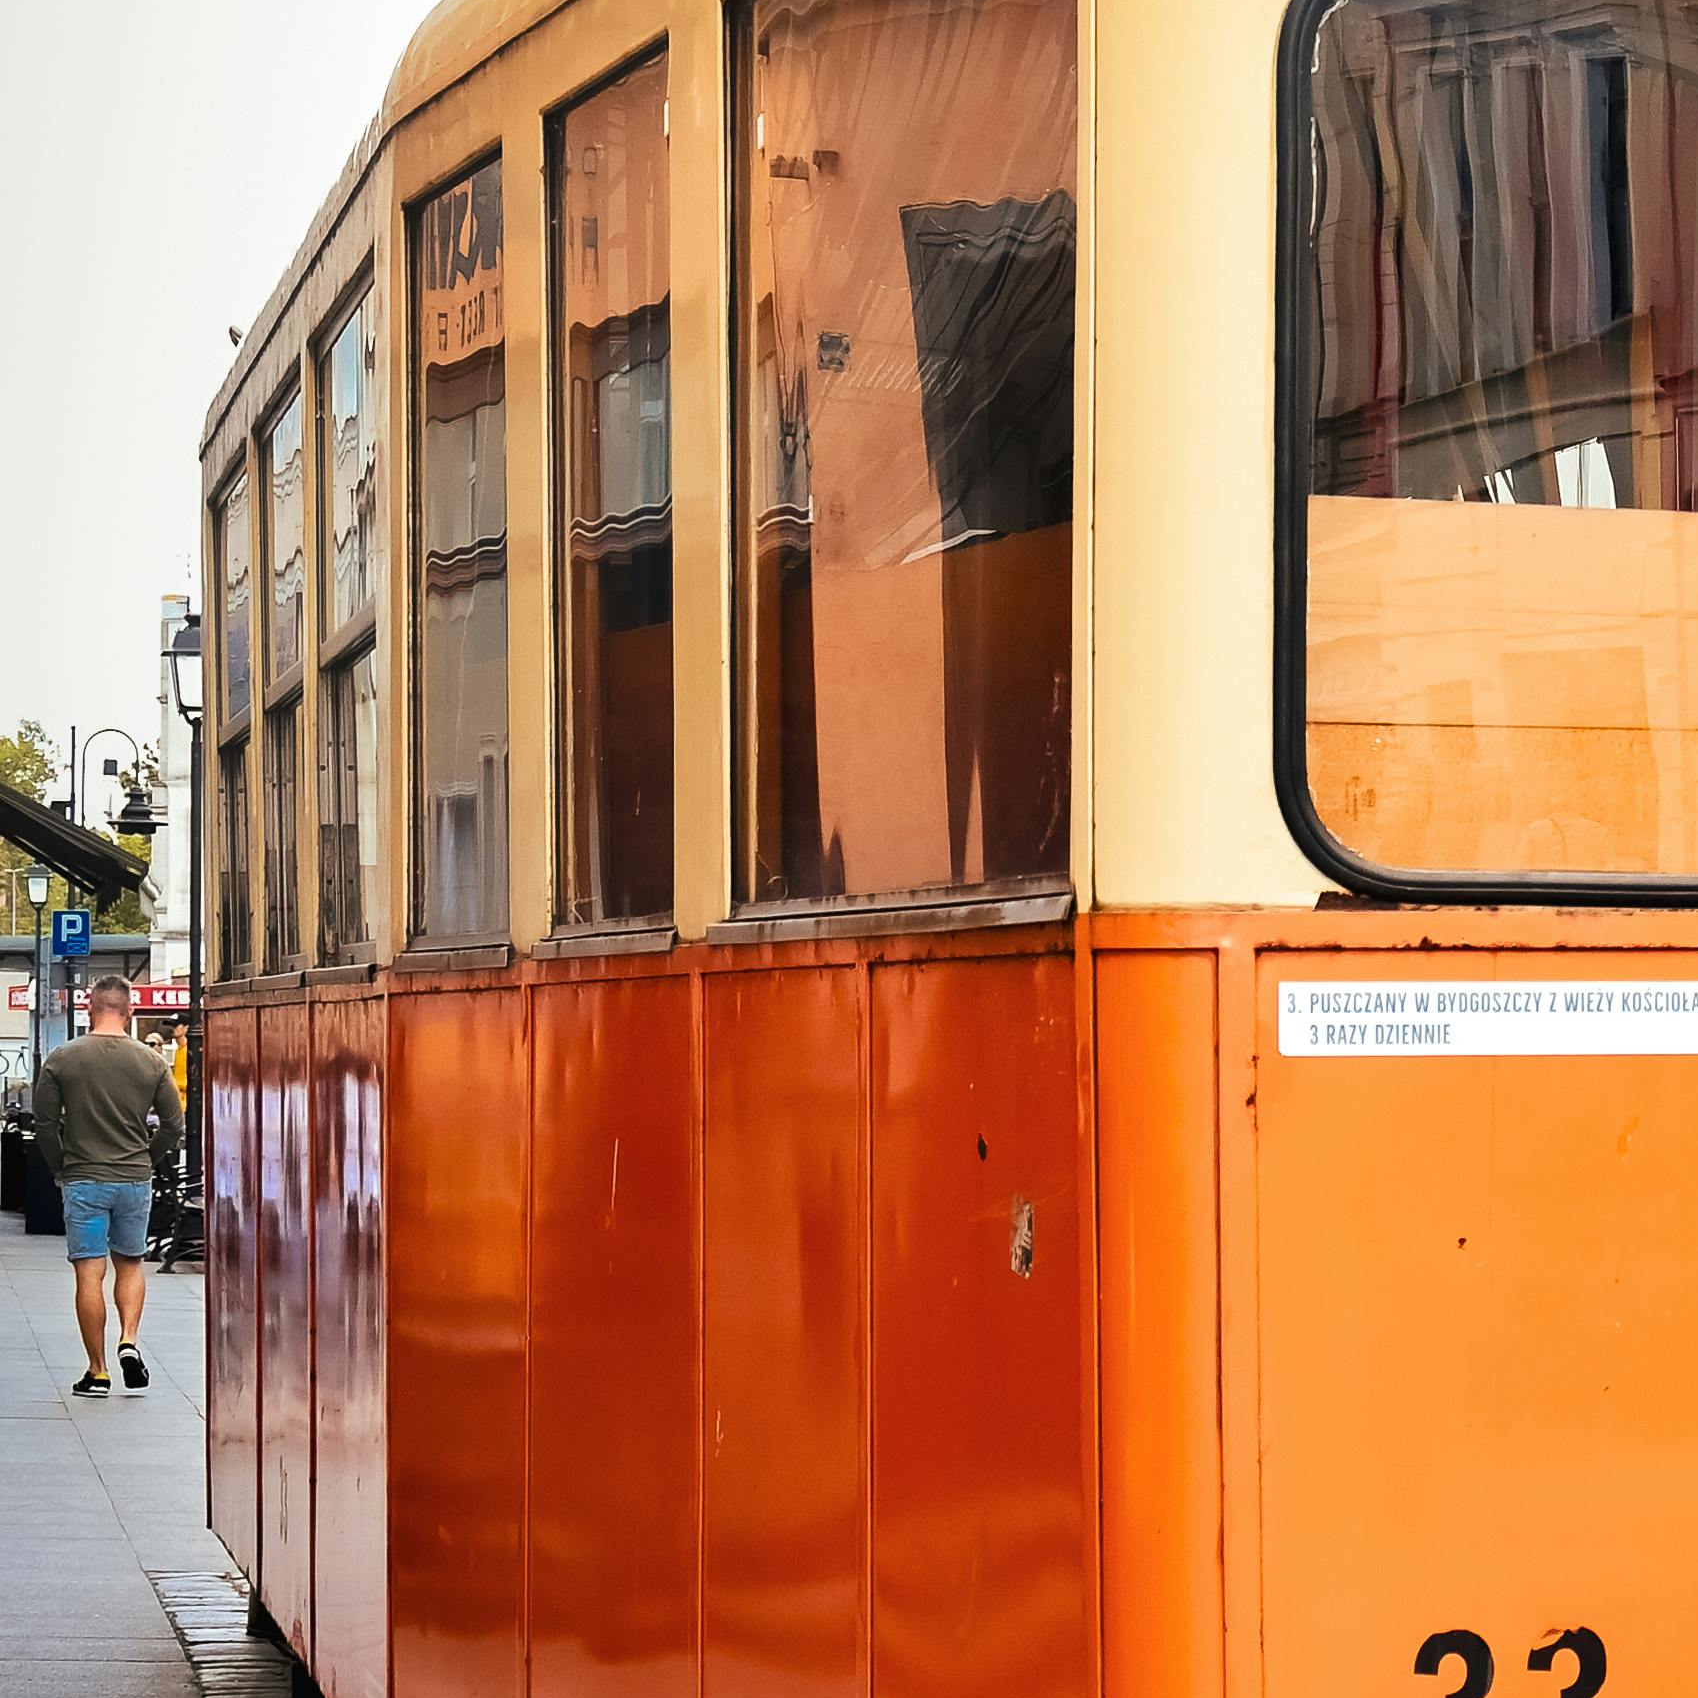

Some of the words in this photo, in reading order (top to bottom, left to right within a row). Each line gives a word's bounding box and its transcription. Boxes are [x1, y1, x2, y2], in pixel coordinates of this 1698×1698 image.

[61, 914, 82, 942] P
[1287, 992, 1303, 1014] 3.
[1309, 992, 1408, 1014] PUSZCZANY
[1414, 992, 1431, 1014] W
[1436, 991, 1543, 1014] BYDGOSZCZY
[1549, 991, 1558, 1013] Z
[1563, 987, 1615, 1013] WIEŻY
[1309, 1023, 1319, 1045] 3
[1325, 1023, 1369, 1045] RAZY
[1374, 1022, 1452, 1045] DZIENNIE
